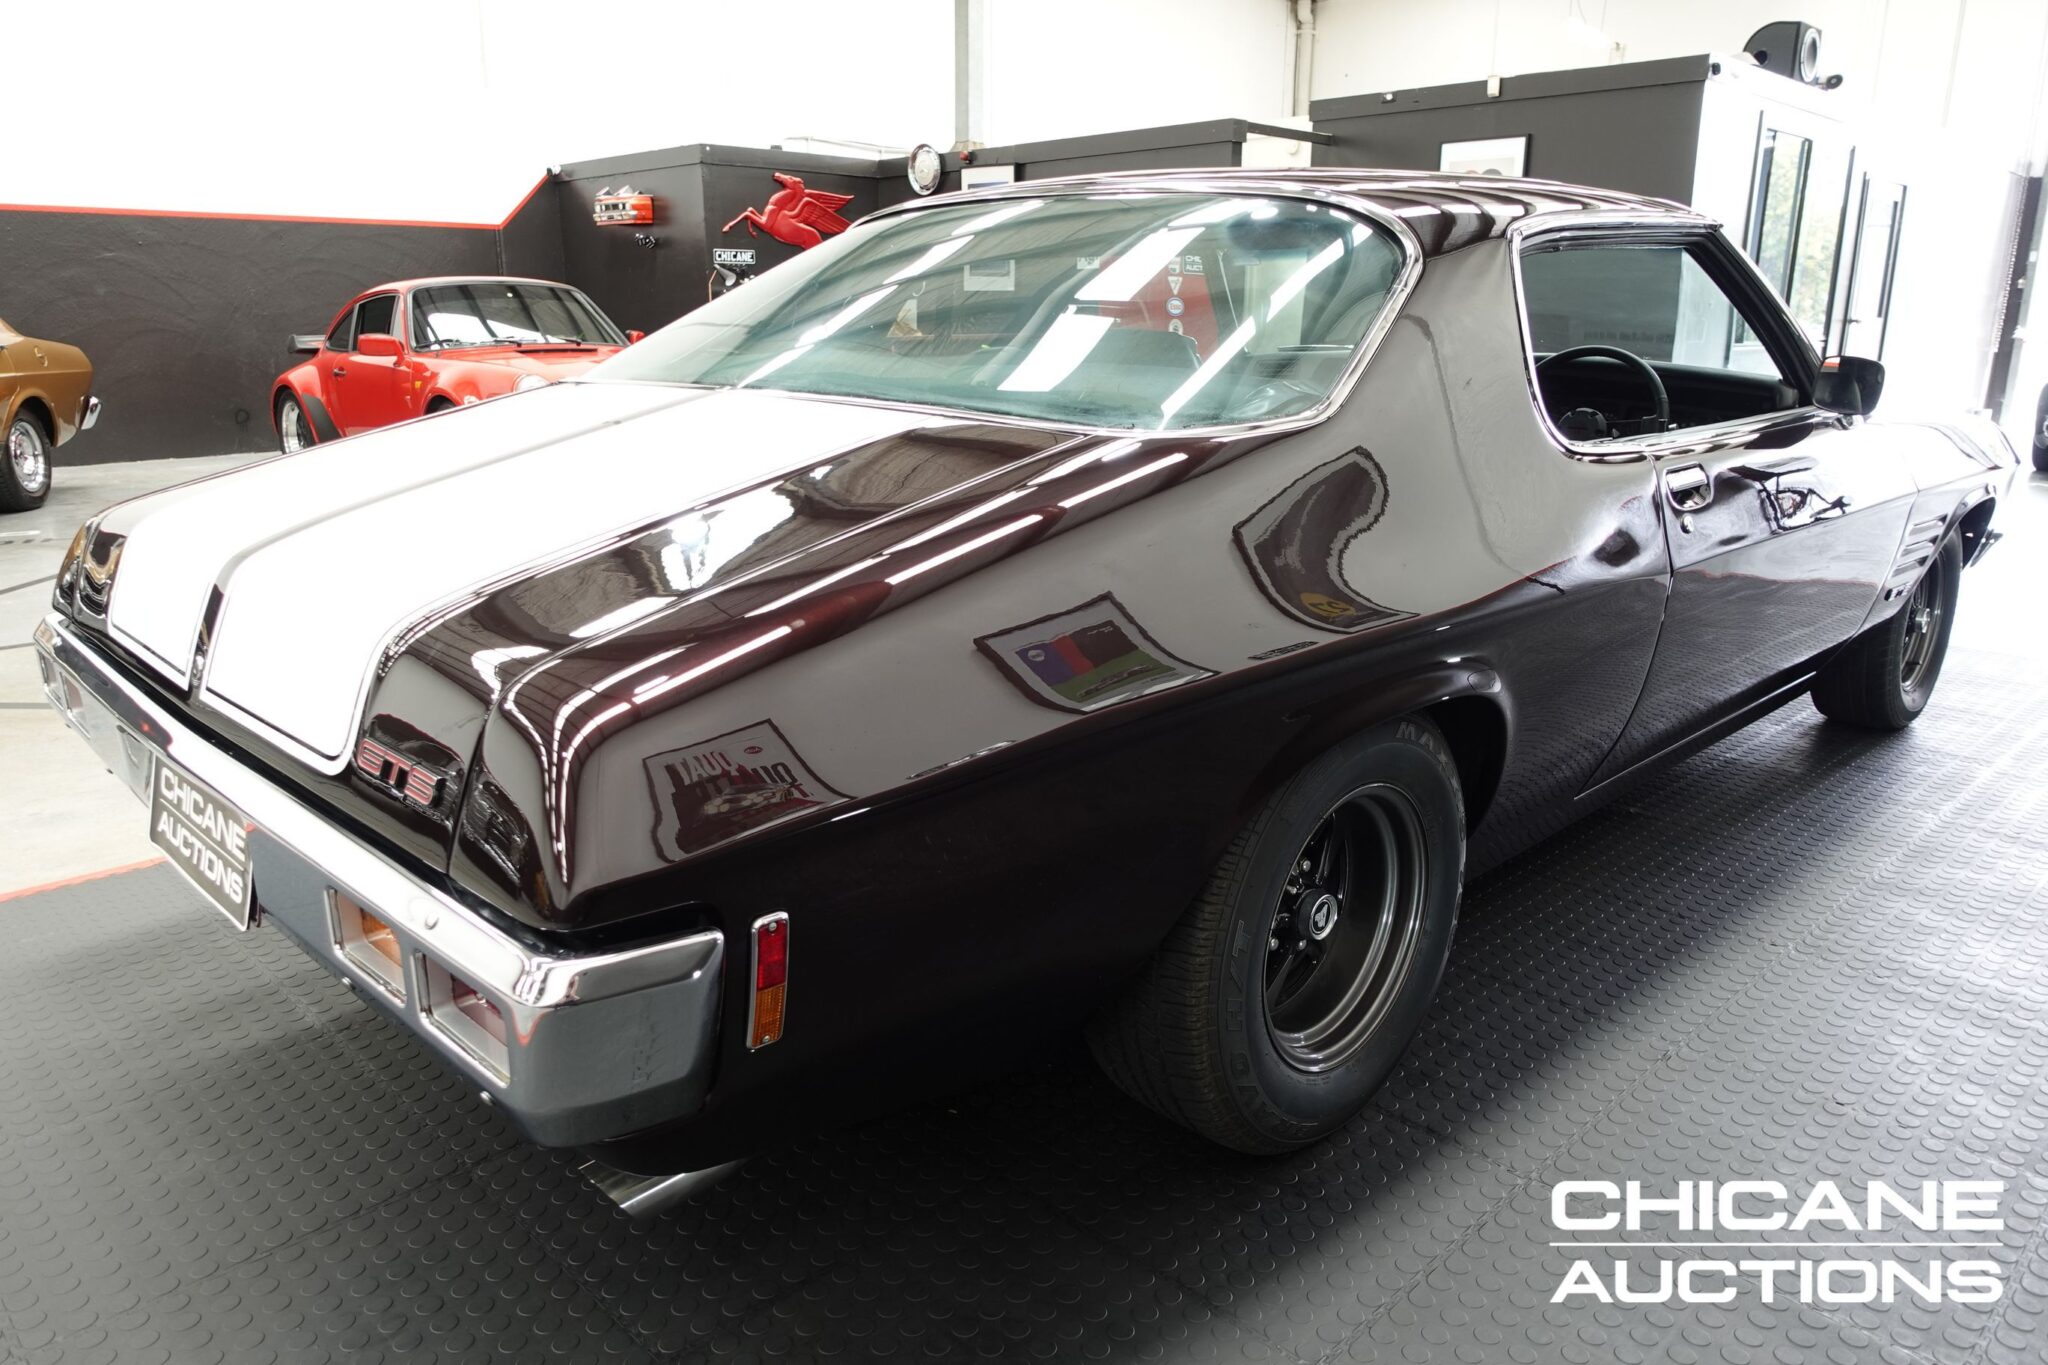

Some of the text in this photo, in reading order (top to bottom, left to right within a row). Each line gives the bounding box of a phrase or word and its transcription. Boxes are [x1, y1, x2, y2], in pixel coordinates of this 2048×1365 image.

[715, 251, 753, 262] CHICANE
[157, 811, 243, 904] AUCTIONS
[161, 766, 247, 862] CHICANE
